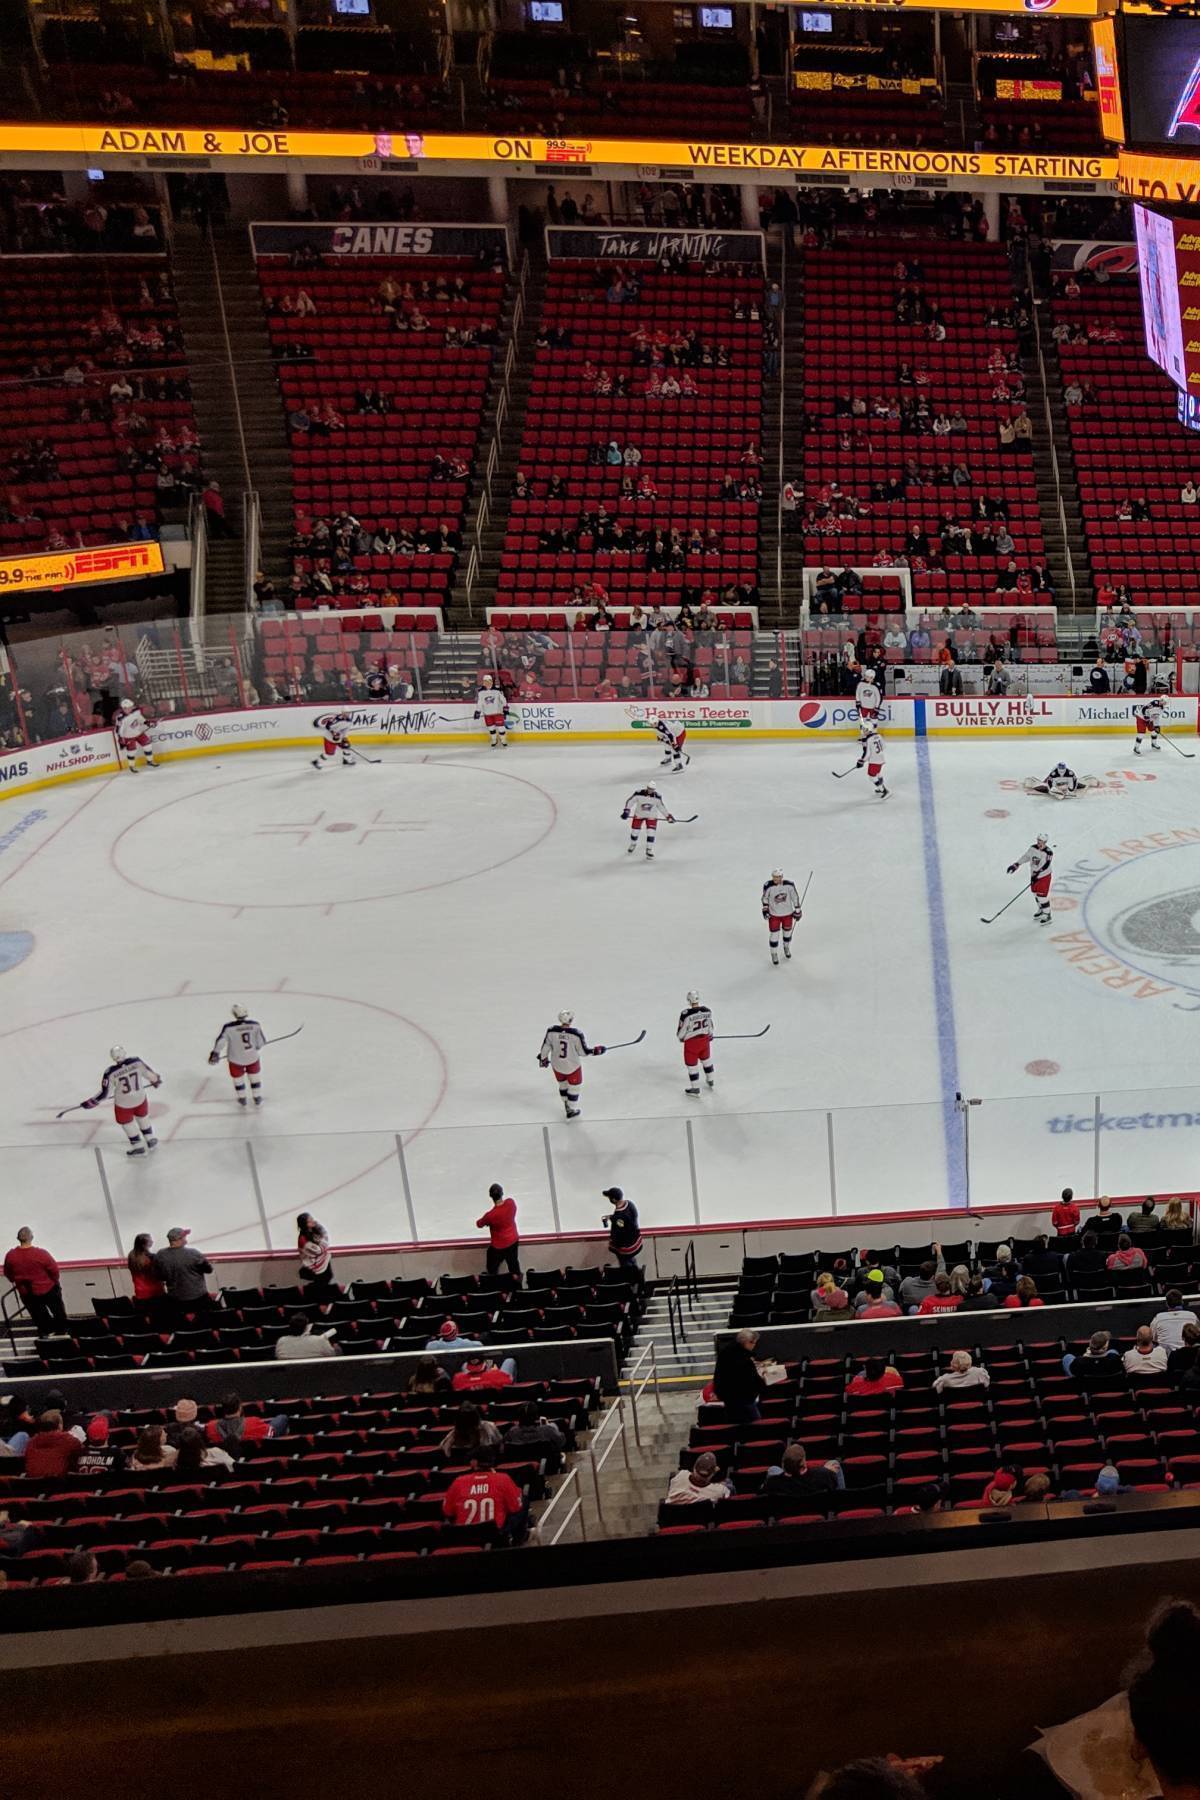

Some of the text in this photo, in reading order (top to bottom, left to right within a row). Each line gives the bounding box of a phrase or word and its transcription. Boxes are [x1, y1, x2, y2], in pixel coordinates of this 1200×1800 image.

[100, 130, 289, 154] ADAM & JOE
[494, 139, 532, 159] ON
[546, 140, 566, 150] 99.9
[362, 159, 377, 169] 101
[545, 150, 586, 162] ESPN
[688, 145, 1102, 177] WEEKDAY AFTERNOONS STARTING
[896, 175, 912, 184] 103
[332, 226, 434, 254] CANES
[597, 232, 727, 260] TAKE WARNING
[75, 547, 149, 574] ESPN
[0, 568, 23, 585] 9.9
[522, 707, 555, 718] DUKE
[644, 707, 750, 720] Harris Teeter
[832, 705, 892, 722] pesi
[935, 701, 1000, 716] BULLY
[1079, 706, 1186, 719] Michael Son
[350, 708, 436, 735] TAKE WARNING
[523, 719, 572, 730] ENERGY
[956, 717, 1034, 726] VINEYARDS
[150, 719, 280, 744] ECTOR SECURITY
[0, 762, 29, 782] NAS
[1057, 858, 1109, 896] PNC
[1049, 929, 1177, 999] ARENA
[241, 1032, 252, 1050] 9
[558, 1040, 568, 1059] 3
[118, 1071, 141, 1095] 37
[470, 1483, 489, 1495] AHO
[463, 1497, 495, 1525] 20
